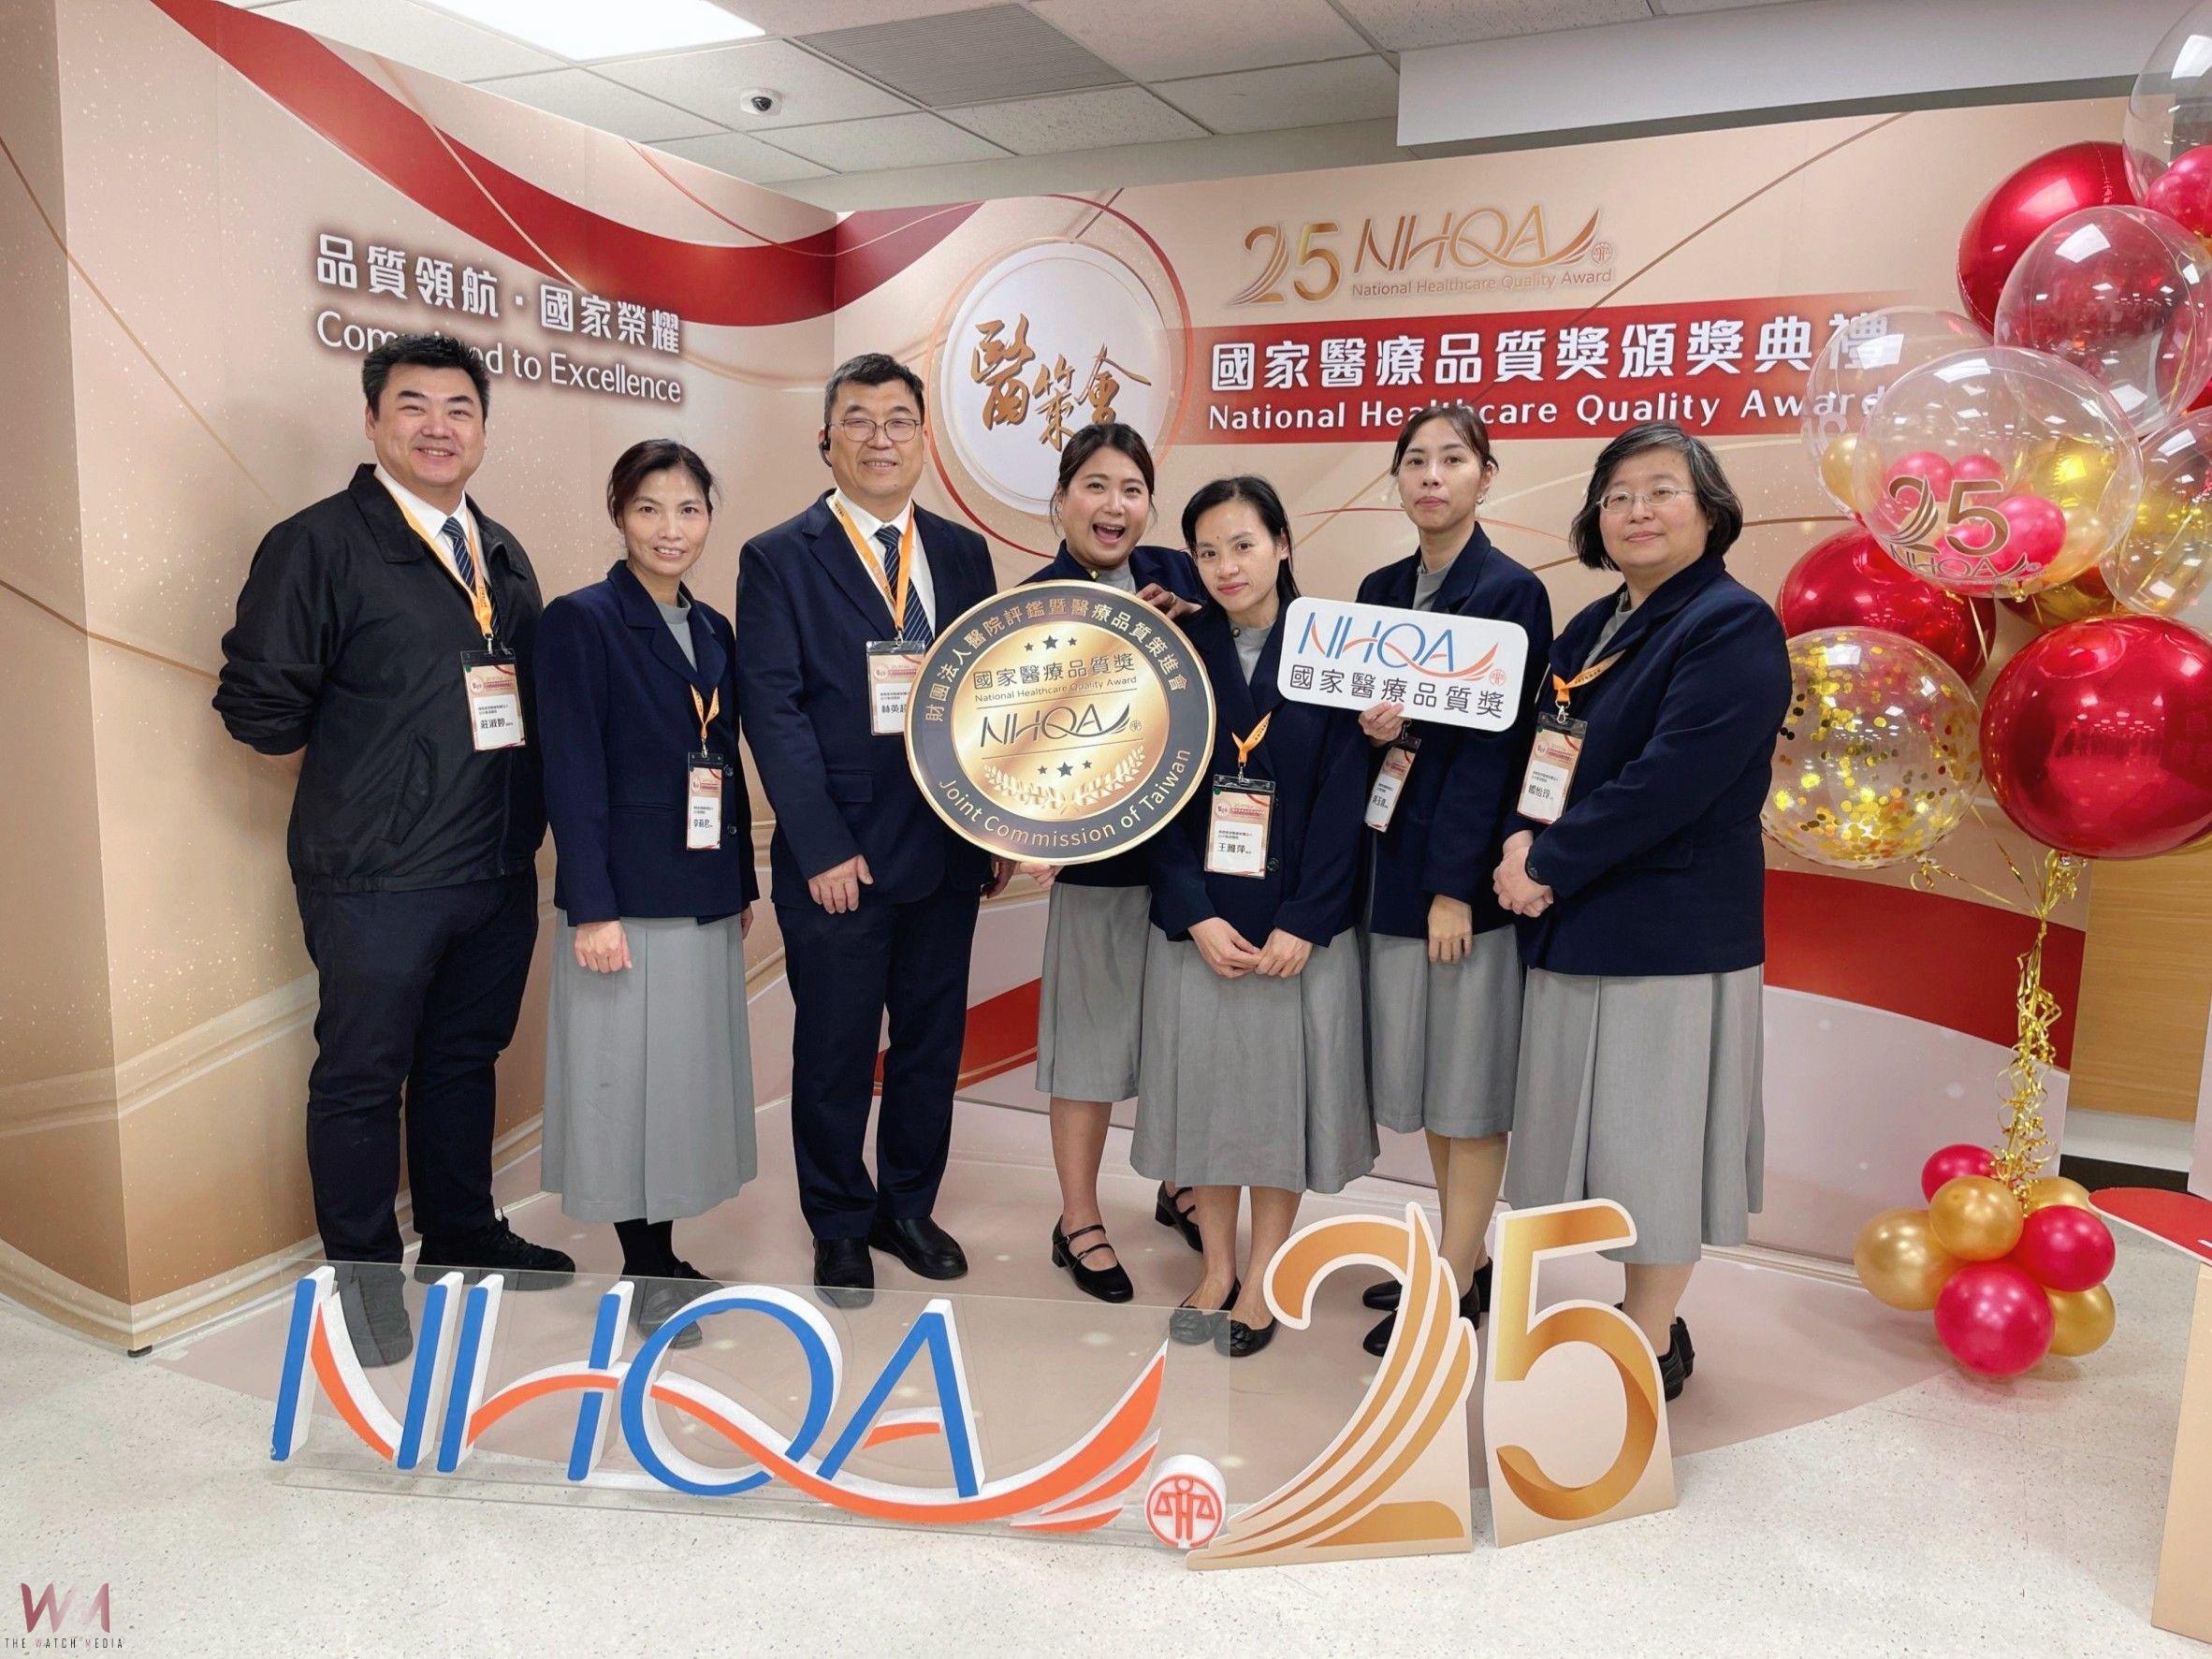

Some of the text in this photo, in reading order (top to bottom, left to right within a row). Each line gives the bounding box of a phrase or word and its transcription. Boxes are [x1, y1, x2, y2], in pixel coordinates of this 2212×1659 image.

[1227, 205, 1600, 305] 25 NHQA
[1352, 268, 1613, 298] National Healthcare Quality Award
[513, 344, 542, 381] to
[550, 352, 682, 403] Excellence
[1209, 401, 1346, 430] National
[1576, 393, 1721, 427] Quality
[1740, 386, 1887, 418] Award
[1882, 473, 2012, 558] 25
[973, 652, 1136, 691] 國家醫療品質獎
[1298, 611, 1500, 682] NHQA
[974, 675, 1138, 704] National Healthcare Quality Award
[1289, 664, 1505, 720] 國家醫療品質獎
[980, 703, 1131, 748] NHQA
[939, 749, 1191, 848] Joint Commission of Taiwan
[270, 1201, 1662, 1563] NHQA 25
